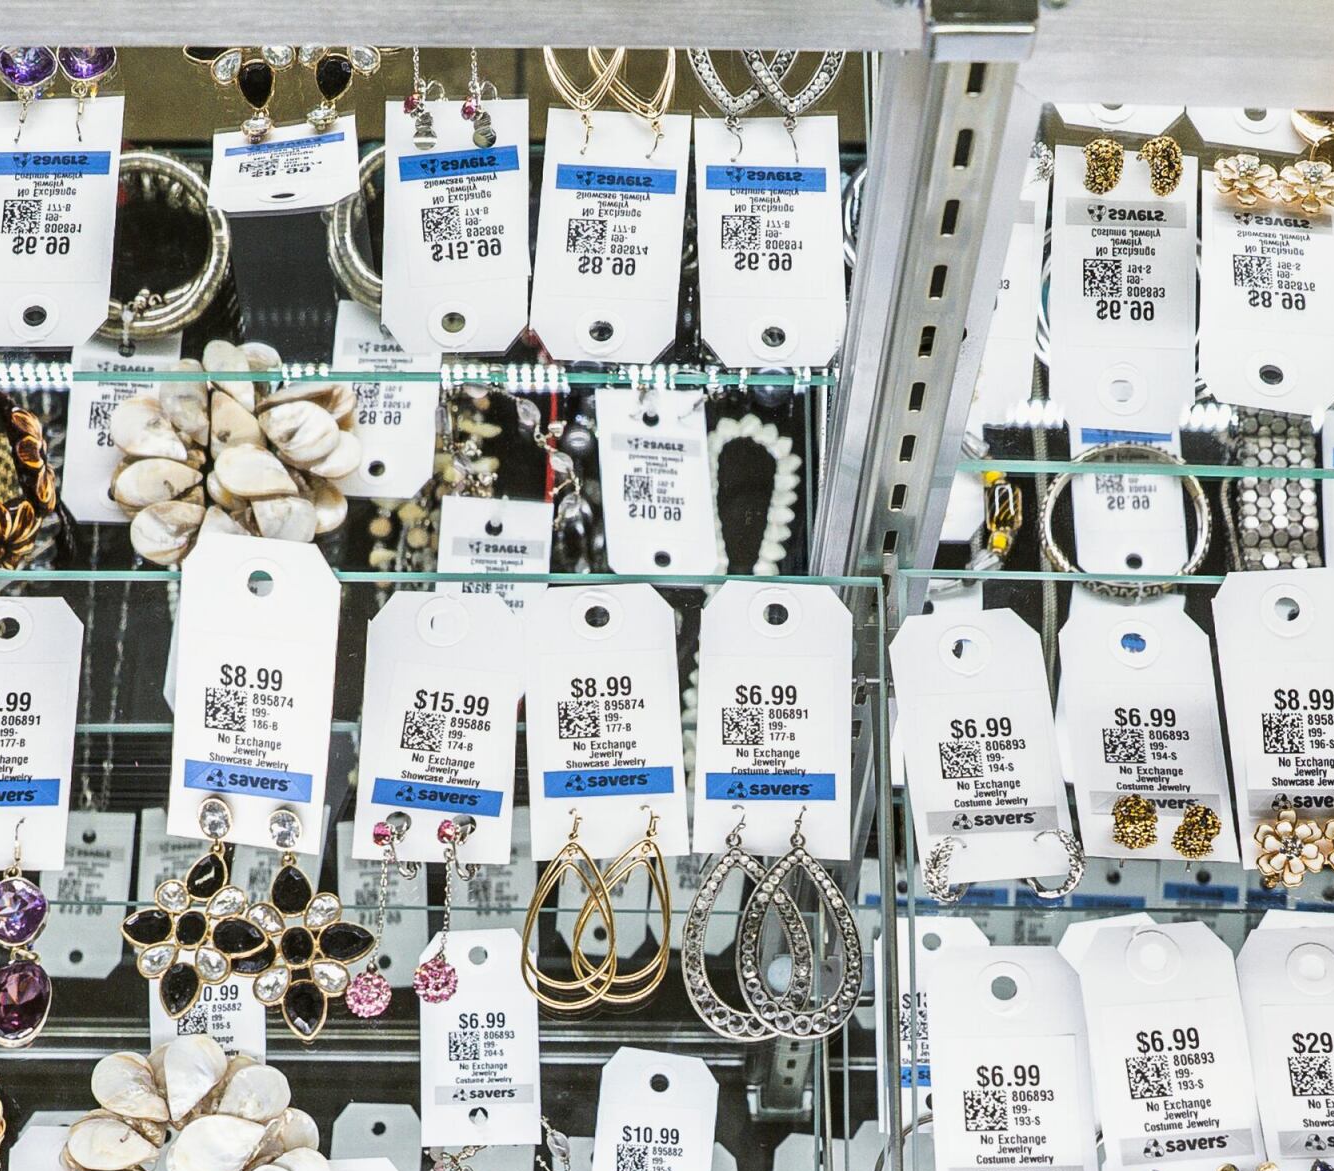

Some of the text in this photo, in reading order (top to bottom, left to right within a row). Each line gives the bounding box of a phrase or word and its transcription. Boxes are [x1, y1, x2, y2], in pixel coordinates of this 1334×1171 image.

[219, 663, 282, 691] $8.99
[570, 675, 631, 700] $8.99
[735, 684, 797, 706] $6.99
[252, 692, 293, 708] 895874
[413, 688, 489, 716] $15.99
[1273, 688, 1334, 712] $8.99
[768, 708, 807, 719] 806891
[1114, 707, 1176, 731] $6.99
[449, 716, 490, 731] 895886
[950, 716, 1011, 742] $6.99
[1148, 729, 1189, 740] 806893
[736, 747, 800, 759] No Exchange
[730, 766, 806, 776] Costume Jewelry
[228, 772, 291, 791] savers
[586, 772, 649, 787] savers
[973, 811, 1036, 826] savers
[458, 1011, 505, 1030] $6.99
[483, 1030, 515, 1039] 806893
[1135, 1027, 1199, 1055] $6.99
[1173, 1051, 1214, 1066] 806893
[976, 1064, 1040, 1089] $6.99
[469, 1088, 515, 1099] savers
[1013, 1115, 1040, 1126] 193-S
[622, 1124, 679, 1145] $10.99
[980, 1133, 1046, 1145] No Exchange
